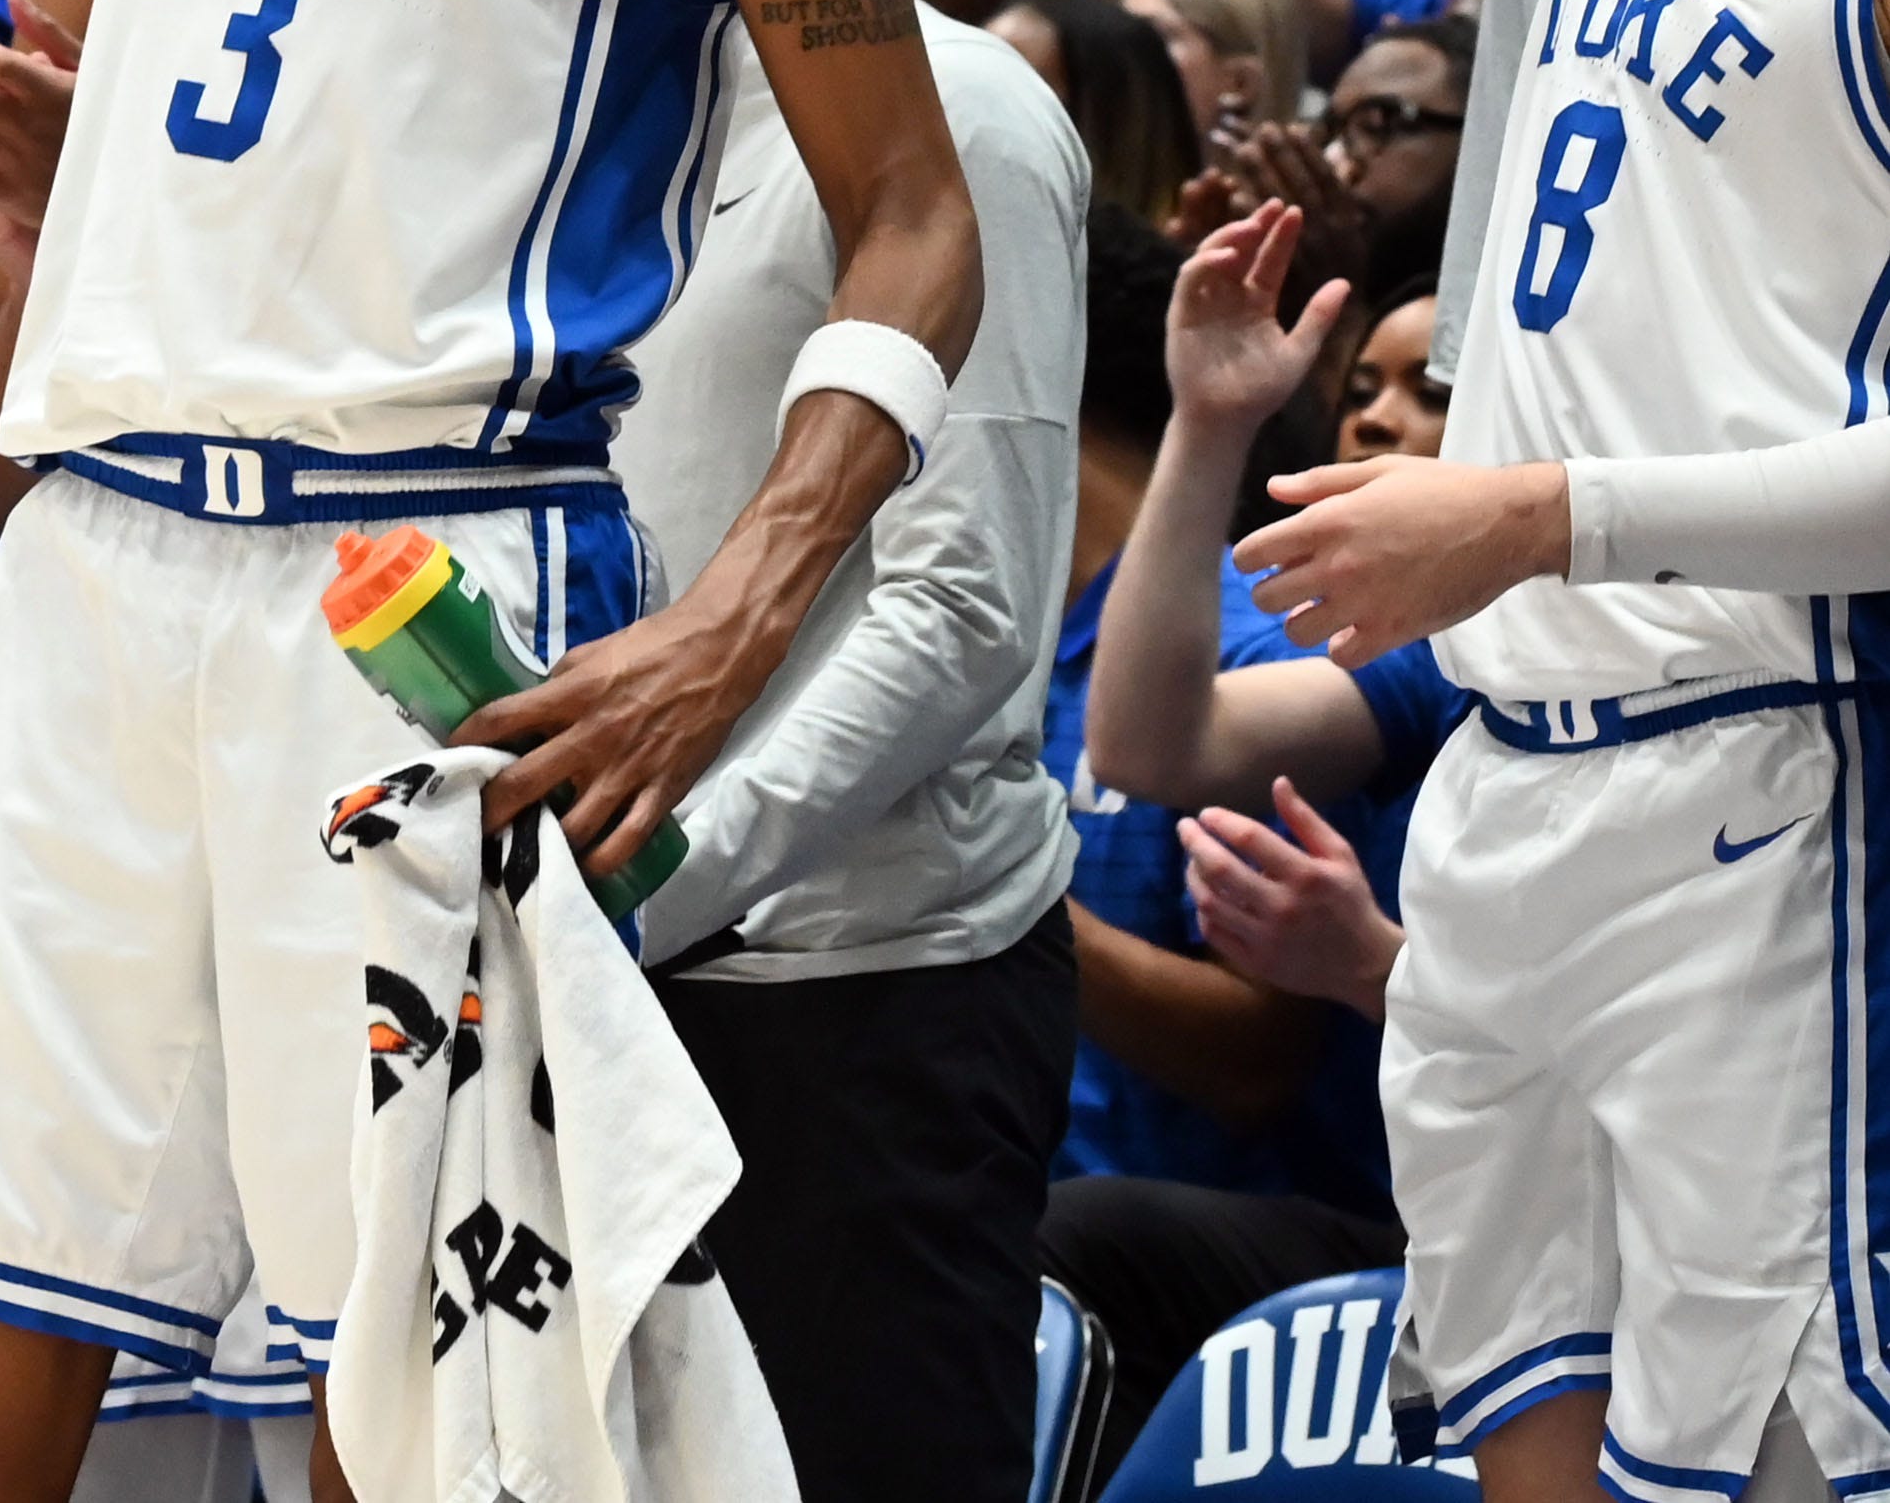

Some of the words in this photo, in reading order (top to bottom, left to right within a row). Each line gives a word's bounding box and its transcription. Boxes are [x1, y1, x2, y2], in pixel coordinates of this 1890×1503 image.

[761, 0, 810, 24] BUT
[1512, 99, 1628, 335] 8
[202, 444, 266, 518] D
